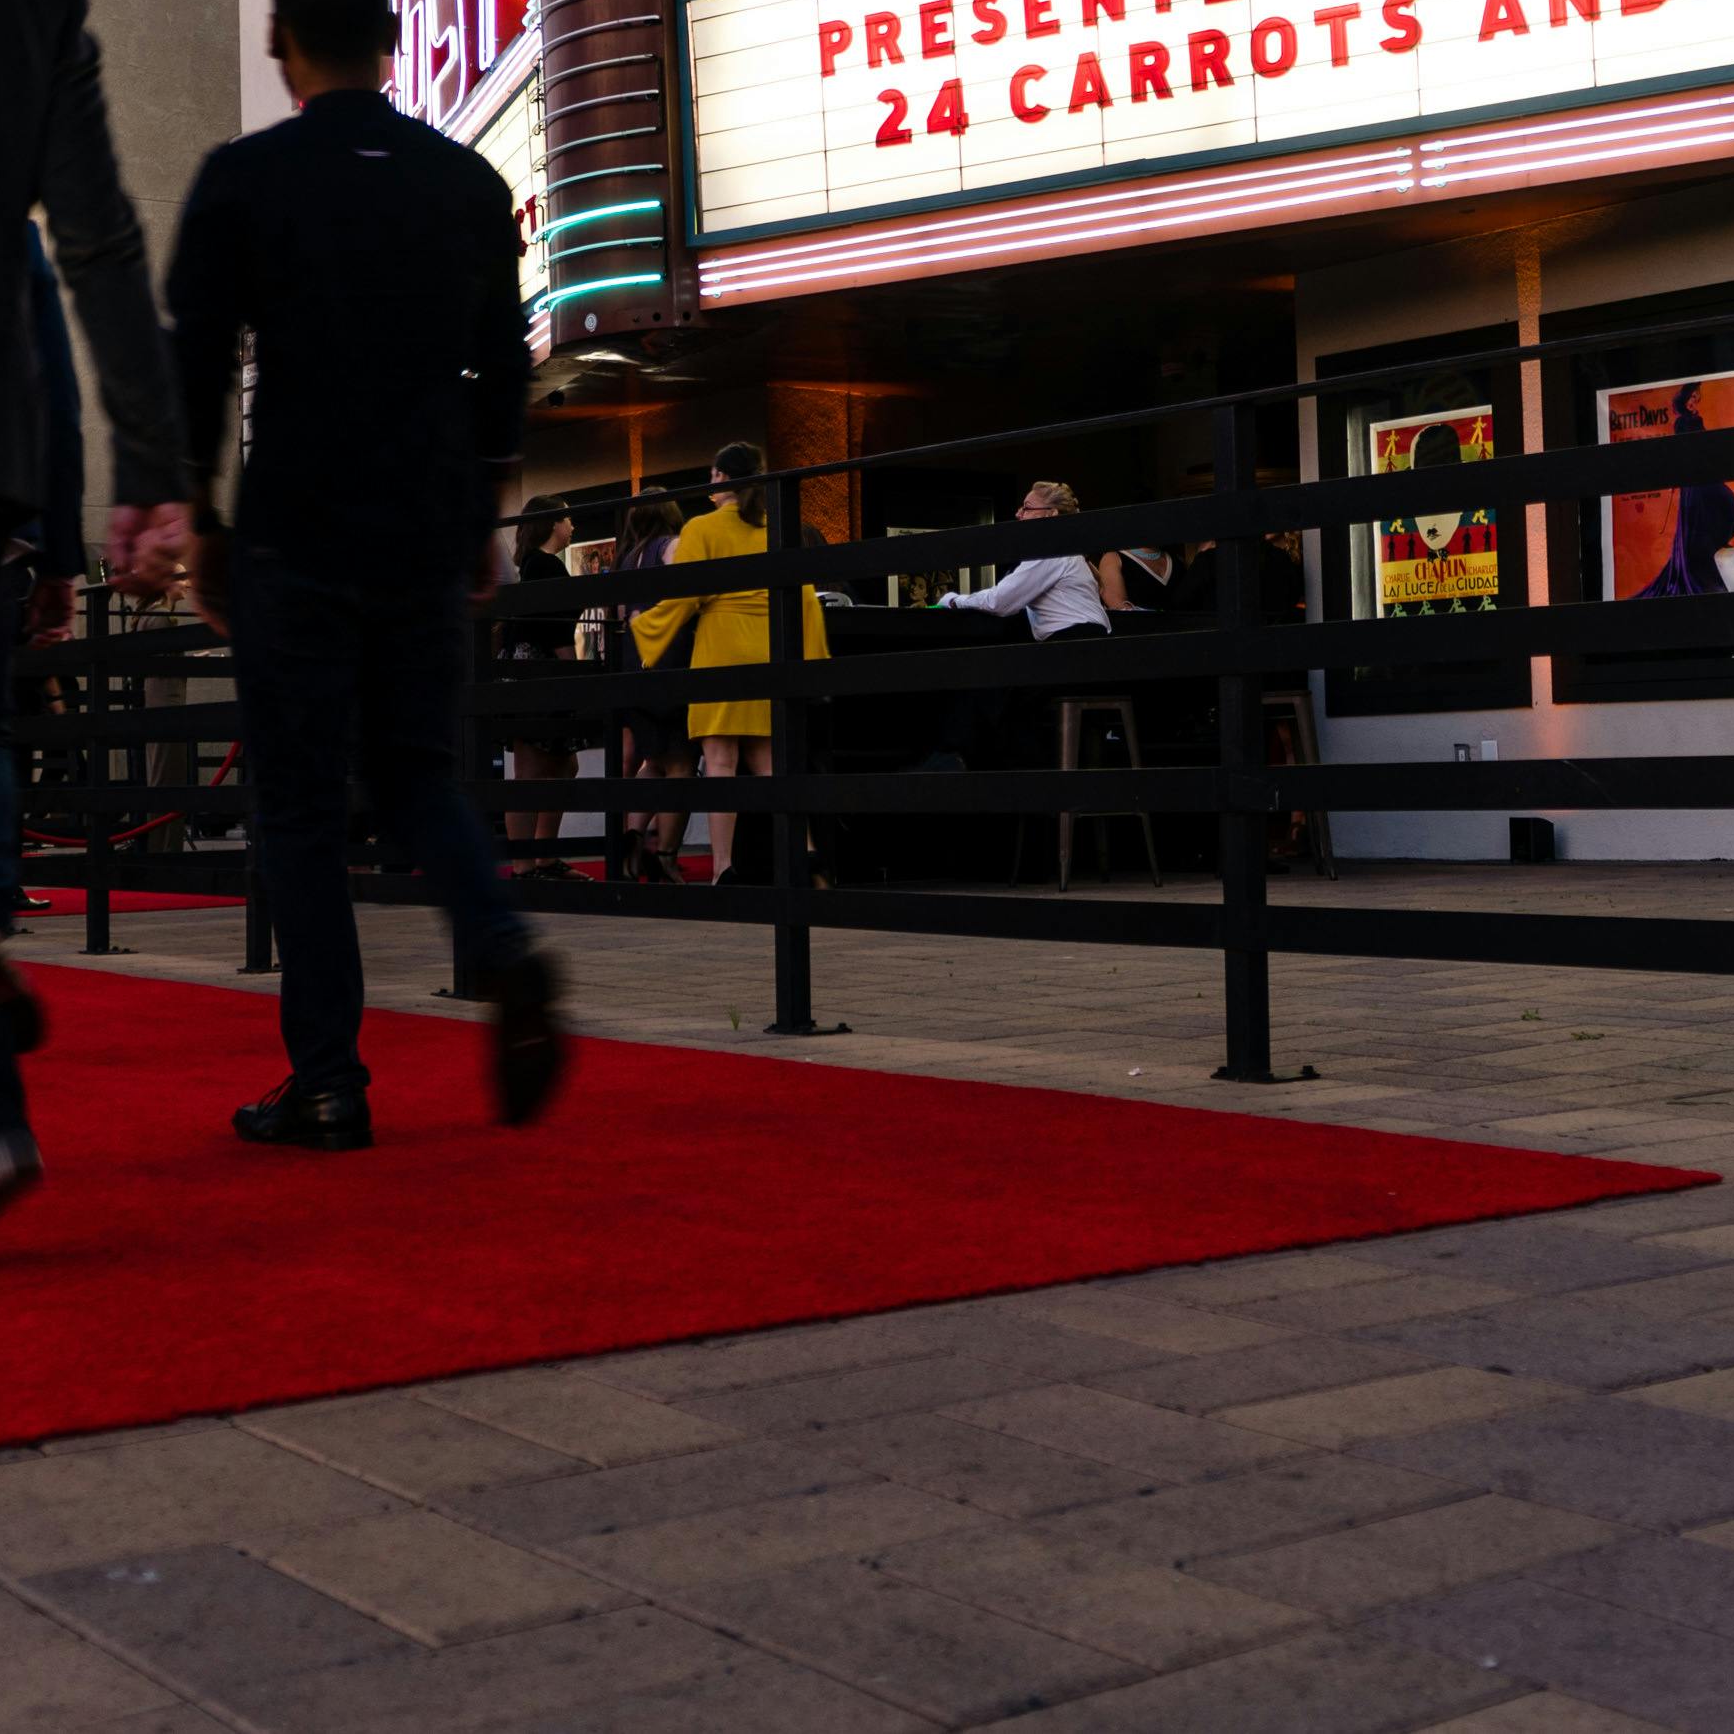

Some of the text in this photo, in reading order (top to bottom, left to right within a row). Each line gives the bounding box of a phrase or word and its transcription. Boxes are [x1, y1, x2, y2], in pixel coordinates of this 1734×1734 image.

[875, 77, 970, 148] 24
[1609, 404, 1669, 431] BETTE DAVIS
[1414, 558, 1467, 583] CHAPLIN
[1383, 584, 1400, 598] LAS
[1405, 581, 1439, 595] LUCES
[1456, 575, 1499, 591] CIUDAD
